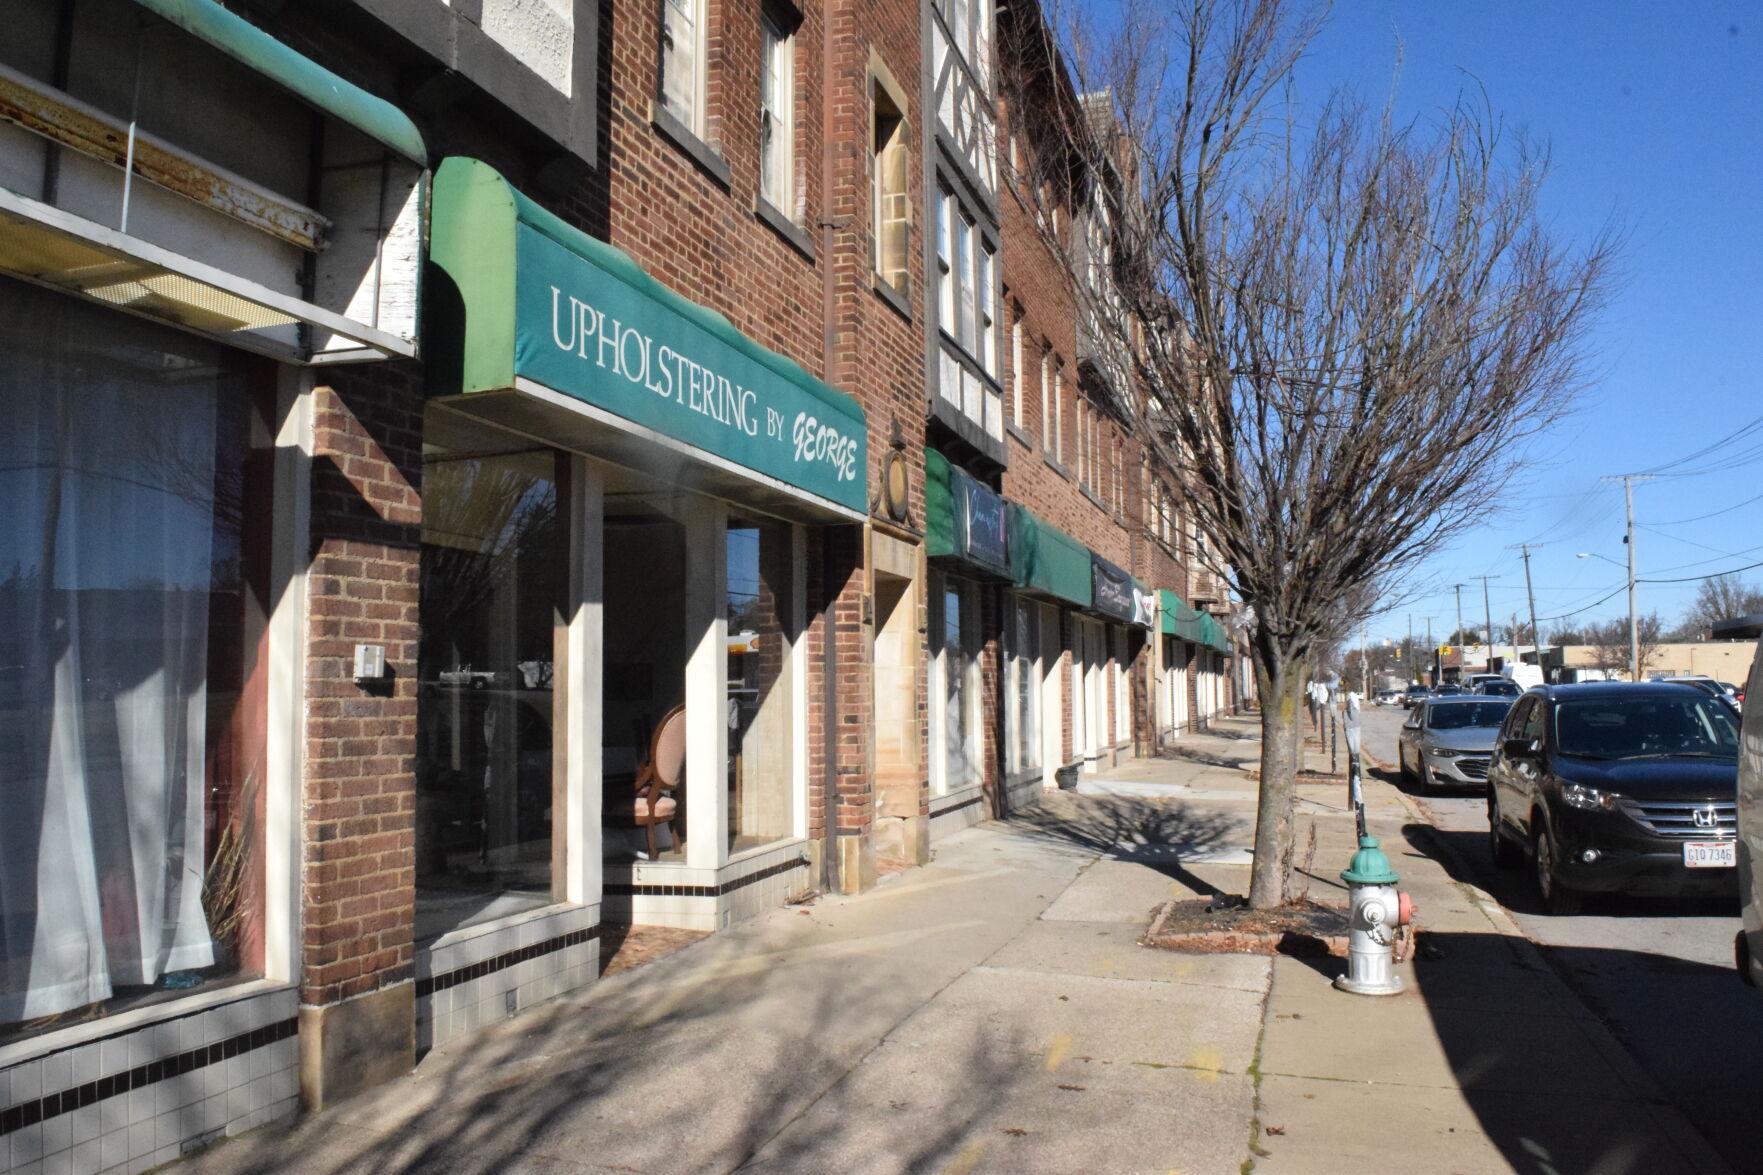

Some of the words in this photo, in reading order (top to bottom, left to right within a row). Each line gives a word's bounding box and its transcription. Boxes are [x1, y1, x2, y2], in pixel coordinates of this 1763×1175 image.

[550, 285, 758, 437] UPHOLSTERING
[766, 406, 785, 442] BY
[792, 411, 858, 482] GEORGE
[1708, 848, 1732, 861] 7346
